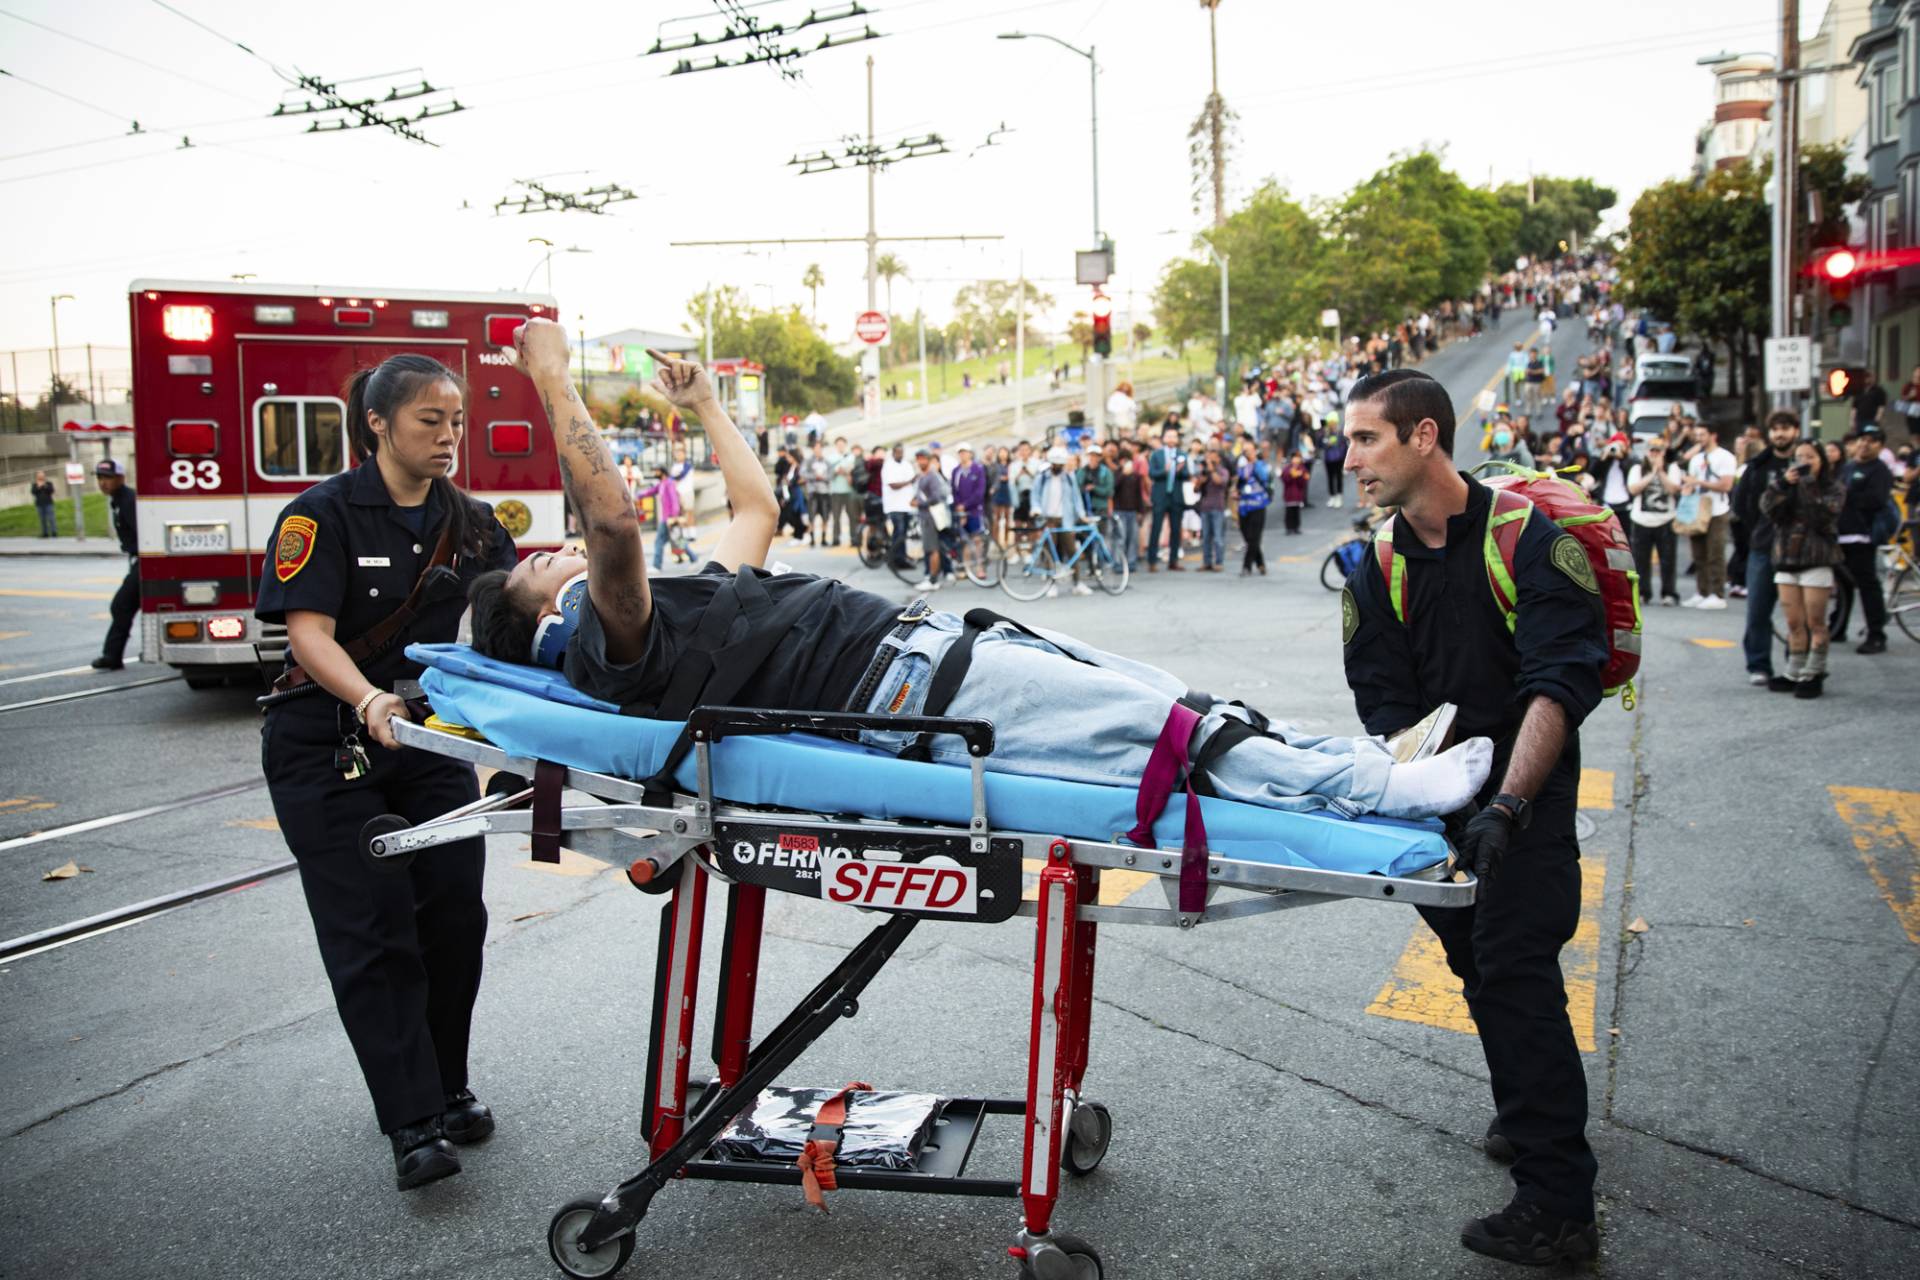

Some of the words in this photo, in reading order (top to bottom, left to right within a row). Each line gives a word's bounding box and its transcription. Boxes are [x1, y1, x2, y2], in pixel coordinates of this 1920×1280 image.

[1778, 342, 1799, 352] NO
[170, 460, 221, 490] 83
[174, 534, 224, 547] 1499192
[782, 836, 815, 850] M583
[828, 862, 967, 907] SFFD
